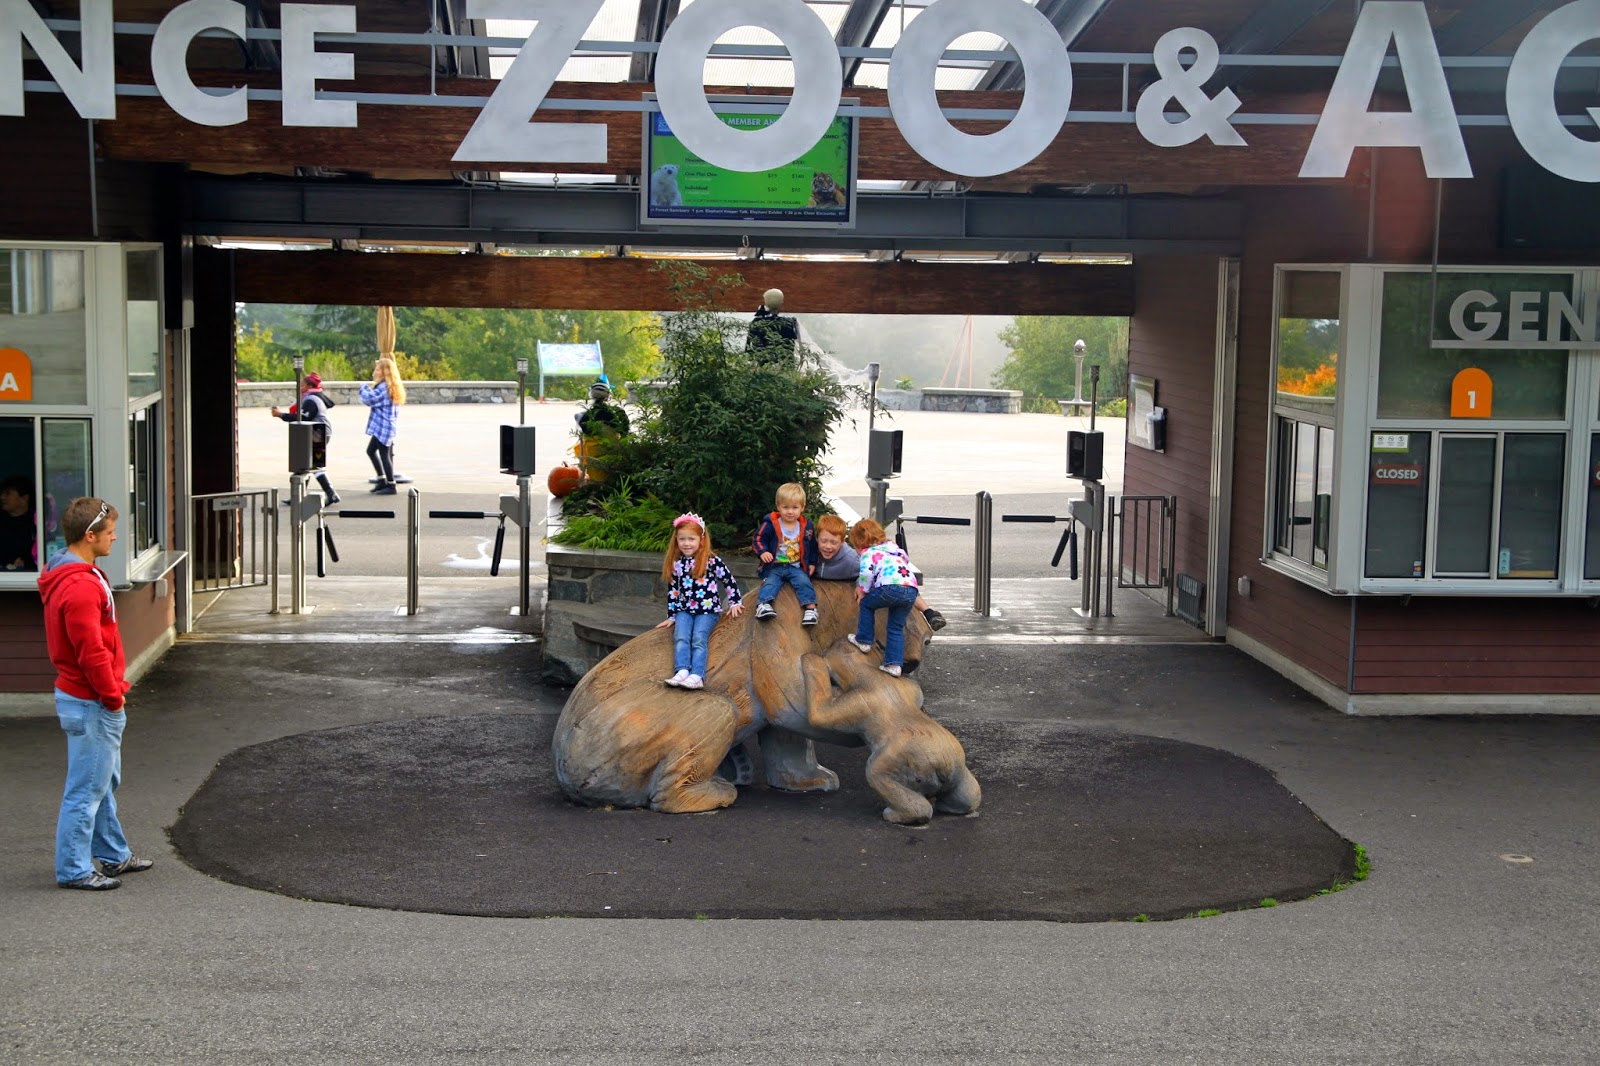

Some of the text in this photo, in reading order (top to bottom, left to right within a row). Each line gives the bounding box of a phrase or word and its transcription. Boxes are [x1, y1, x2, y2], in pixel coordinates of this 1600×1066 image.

[452, 0, 1073, 178] ZOO
[1136, 27, 1248, 147] &
[727, 117, 761, 126] MEMBER
[1449, 290, 1597, 341] GEN
[0, 372, 19, 392] A
[1467, 391, 1476, 409] 1
[1376, 468, 1418, 480] CLOSED
